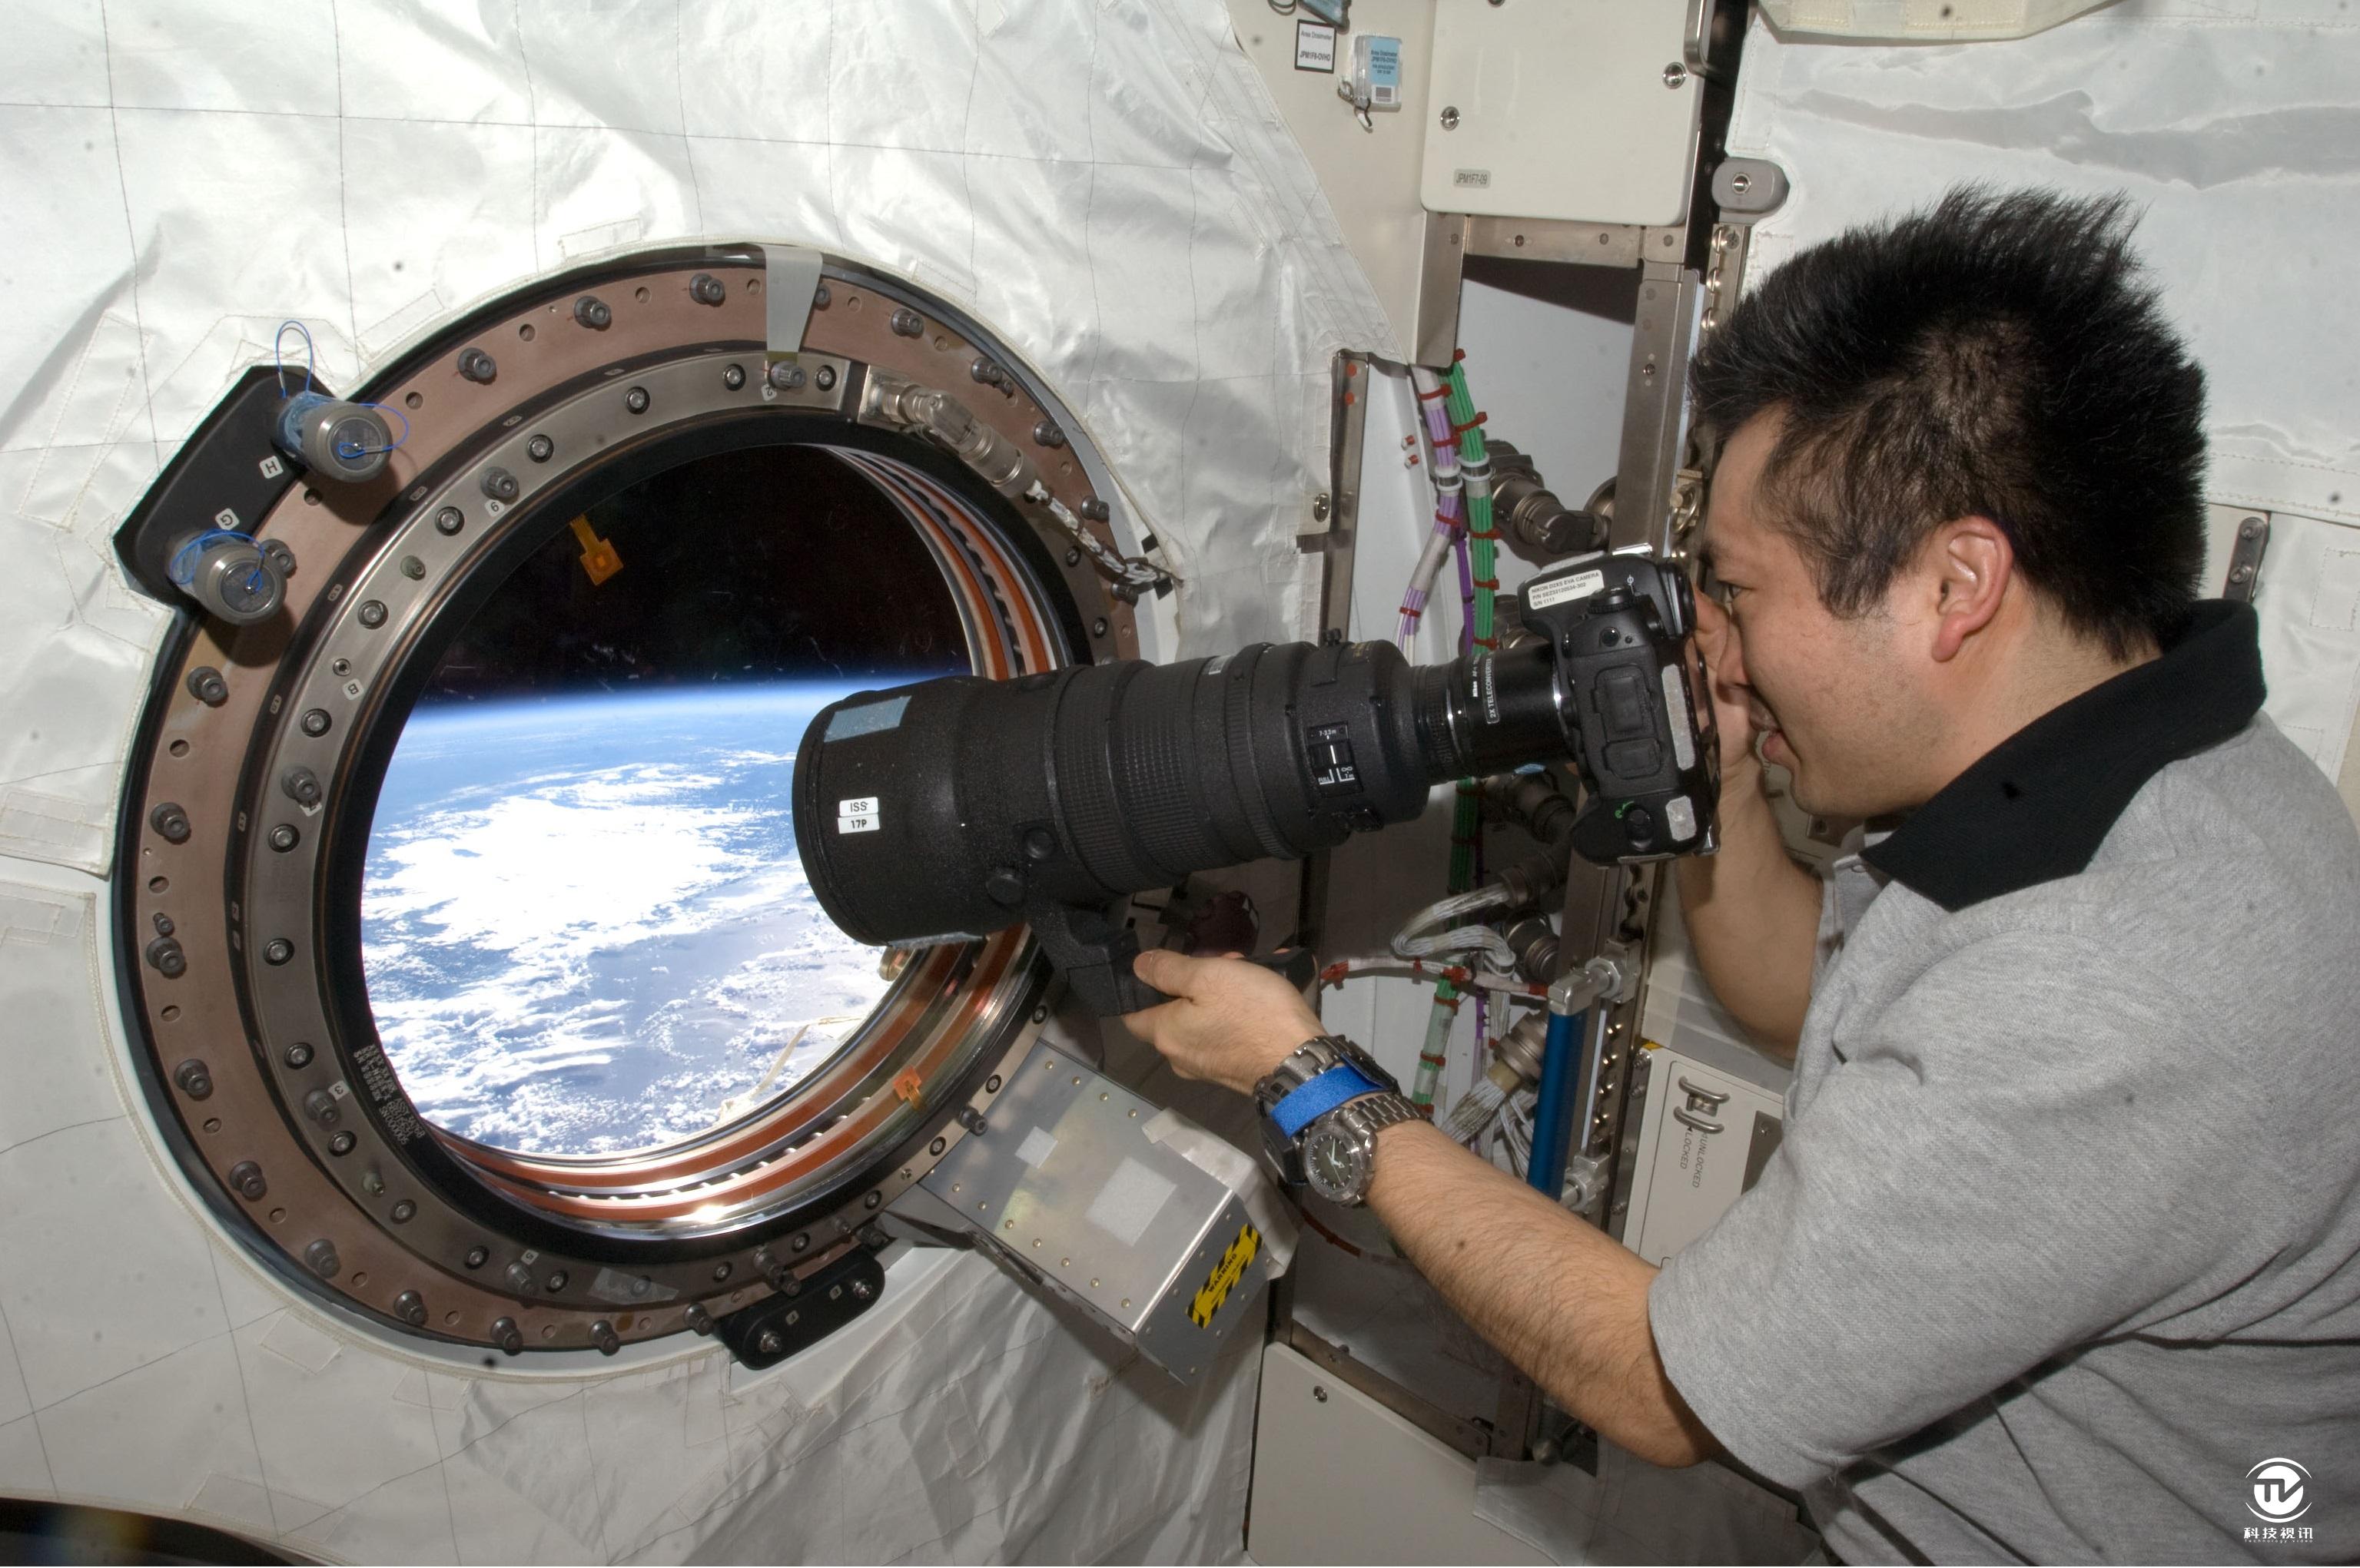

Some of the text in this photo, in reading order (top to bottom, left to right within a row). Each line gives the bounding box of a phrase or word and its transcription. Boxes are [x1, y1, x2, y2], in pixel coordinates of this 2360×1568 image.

[265, 460, 277, 474] H
[1489, 708, 1497, 718] 2X
[850, 801, 868, 813] ISS
[851, 819, 867, 829] 17P
[1680, 1132, 1692, 1169] LOCKED
[1691, 1139, 1708, 1188] UNLOCKED
[1207, 1252, 1237, 1293] WARNING
